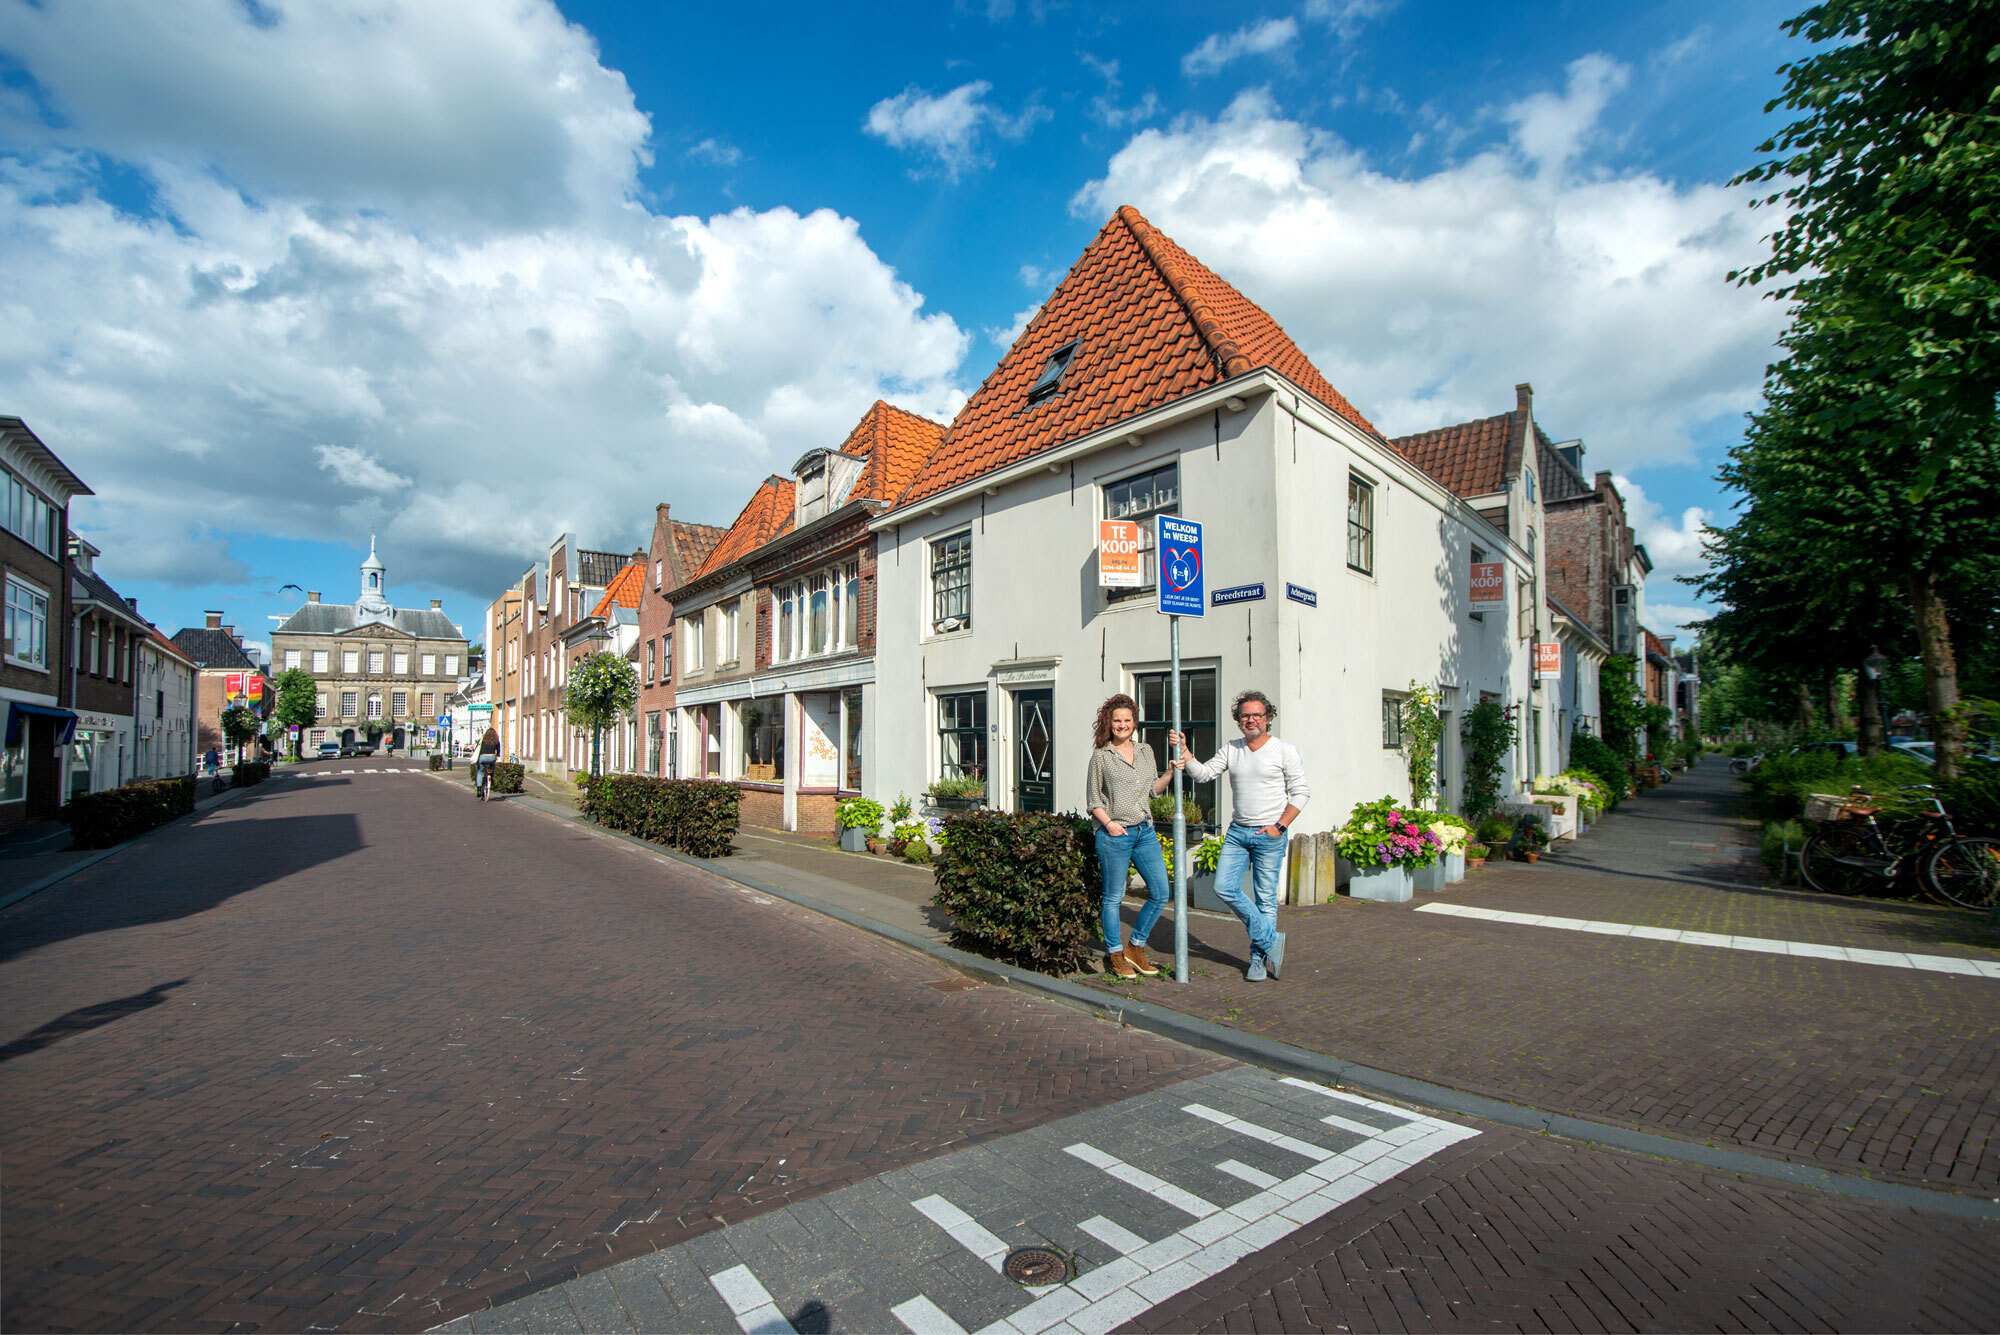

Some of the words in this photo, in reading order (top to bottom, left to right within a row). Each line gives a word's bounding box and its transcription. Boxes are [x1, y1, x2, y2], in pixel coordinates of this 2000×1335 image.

[1111, 525, 1128, 539] TE
[1164, 520, 1198, 535] WELKOM
[1163, 529, 1171, 539] in
[1172, 531, 1199, 544] WEESP
[1101, 539, 1137, 554] KOOP
[1479, 567, 1494, 576] TE
[1471, 576, 1503, 588] KOOP
[1214, 587, 1261, 602] Breedstraat
[1290, 587, 1316, 602] Achtergracht
